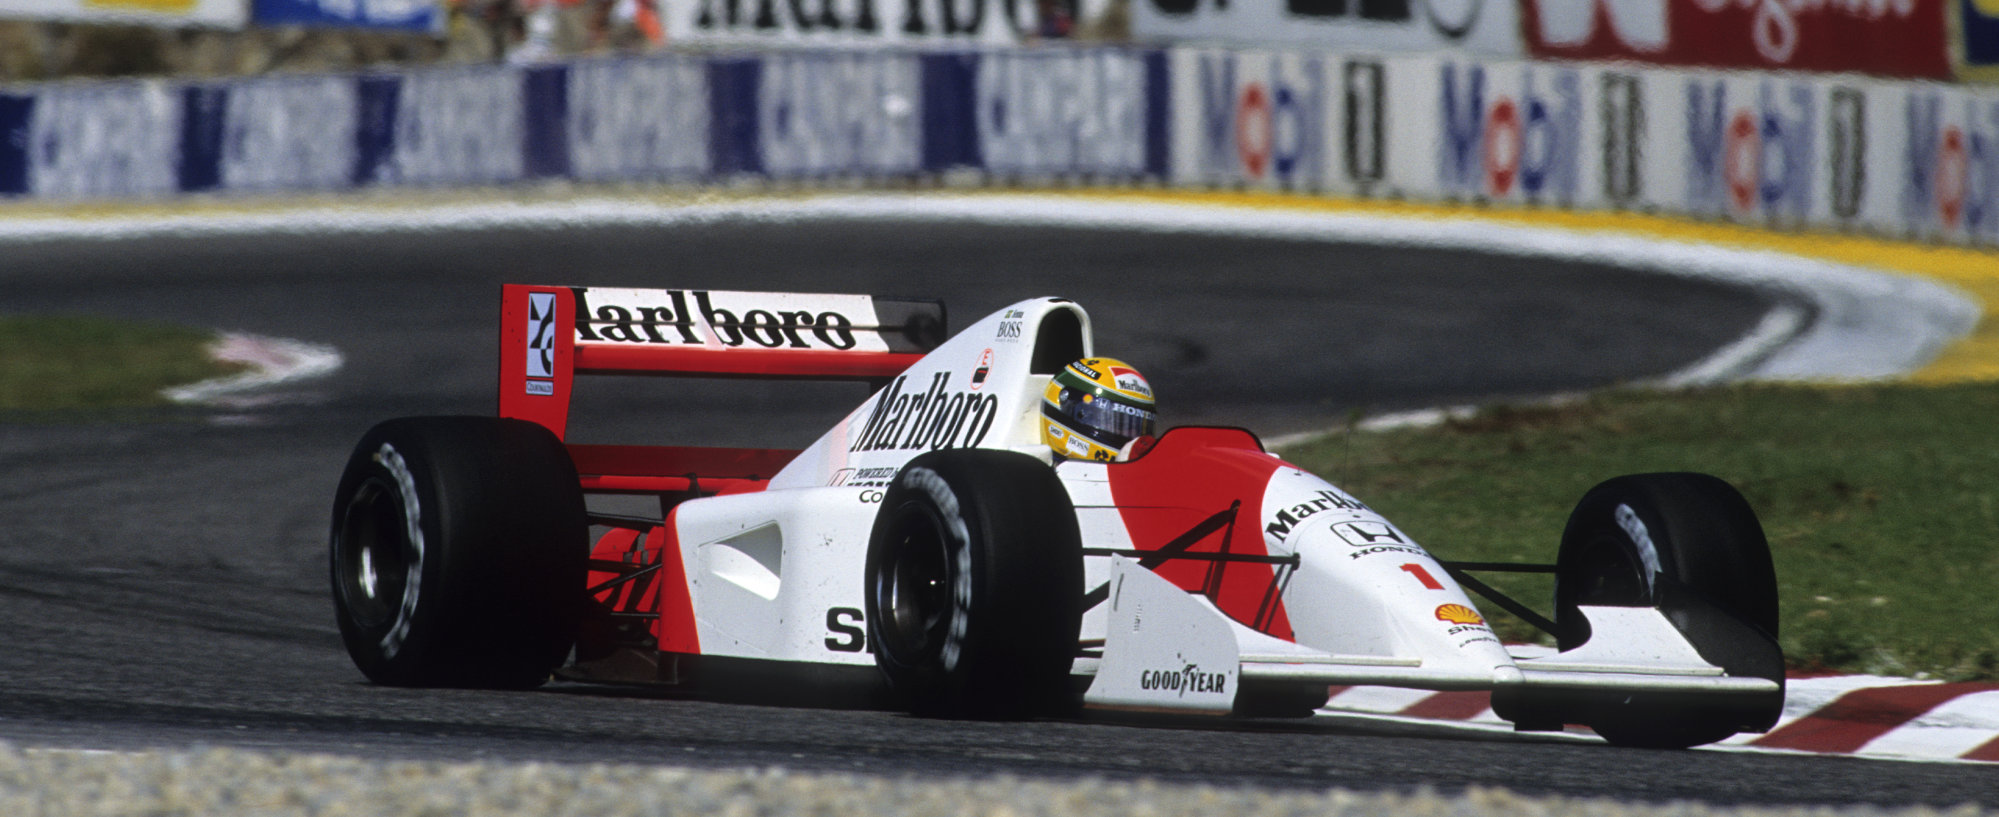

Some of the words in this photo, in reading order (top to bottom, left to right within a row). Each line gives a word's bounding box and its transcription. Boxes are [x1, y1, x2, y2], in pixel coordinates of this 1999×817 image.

[997, 321, 1023, 338] BOSS
[849, 371, 998, 452] Marlboro
[1068, 436, 1090, 452] BOSS
[1400, 563, 1446, 590] 1
[824, 606, 874, 654] S
